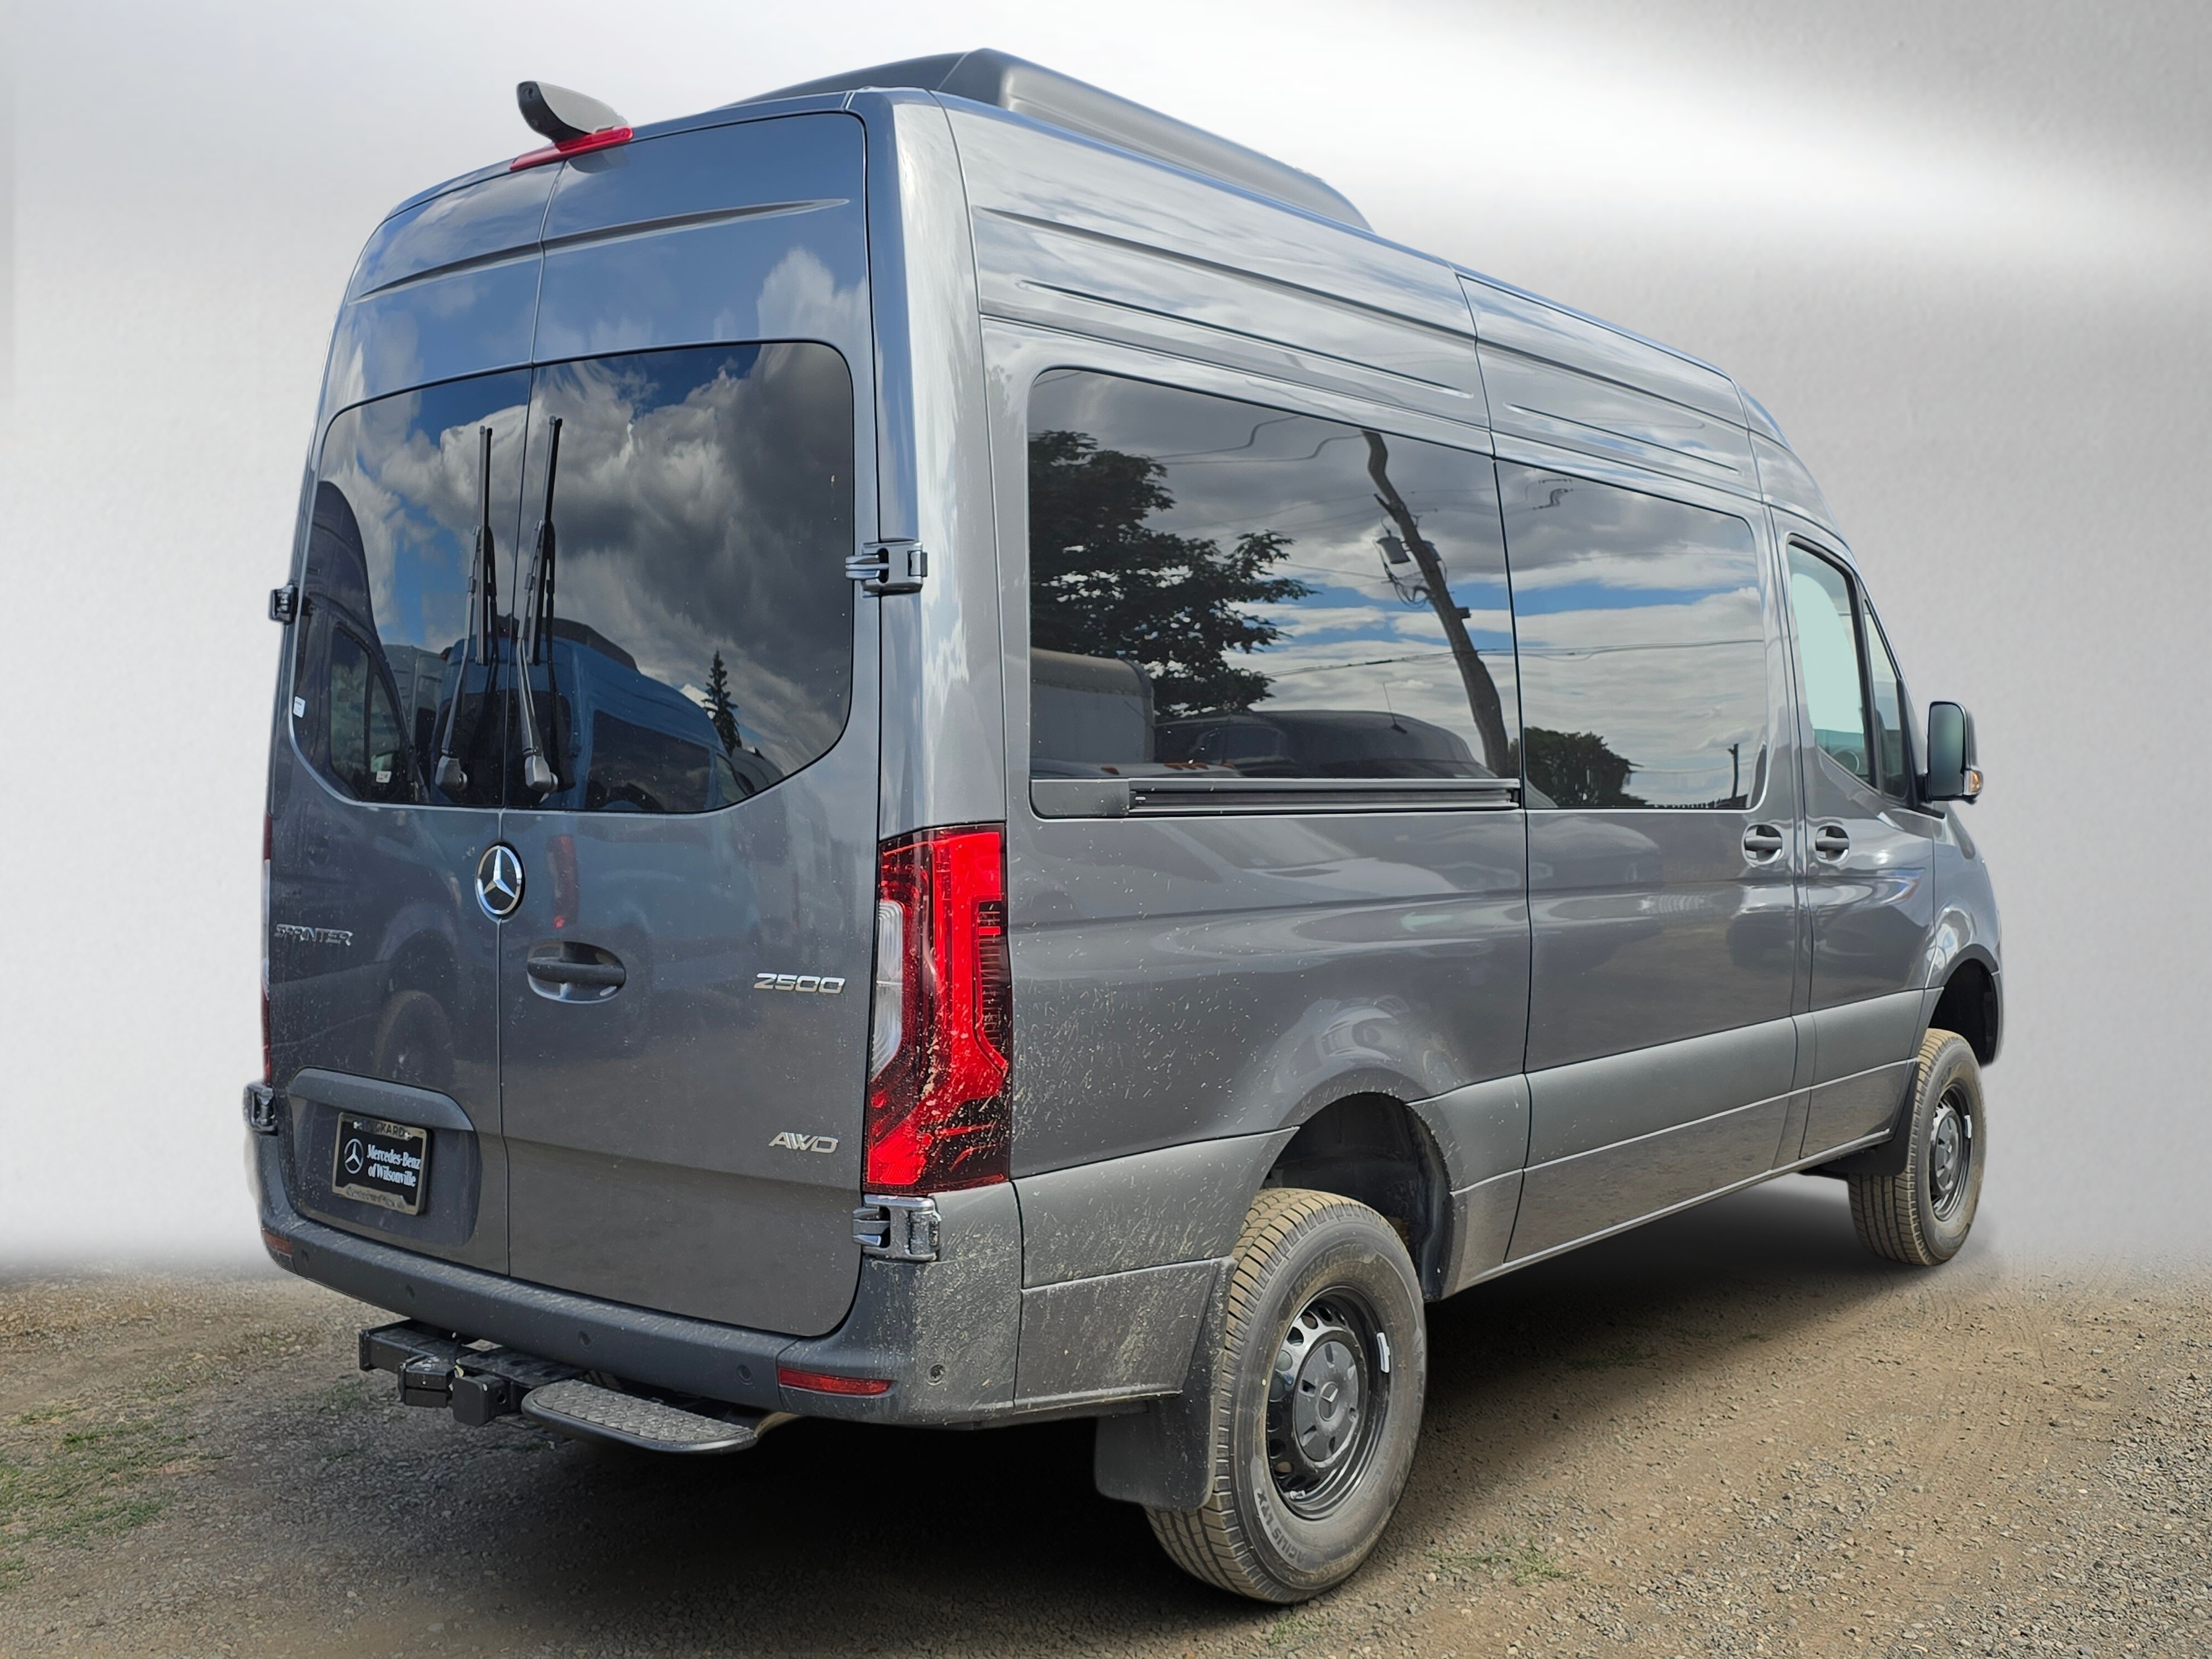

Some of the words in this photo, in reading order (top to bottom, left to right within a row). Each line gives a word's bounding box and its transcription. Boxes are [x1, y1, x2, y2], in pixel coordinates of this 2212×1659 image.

[754, 973, 845, 994] 2500
[768, 1131, 838, 1153] AWD
[367, 1144, 420, 1170] Mercedes-Benz
[368, 1163, 377, 1177] of
[377, 1164, 416, 1187] Wilsonville
